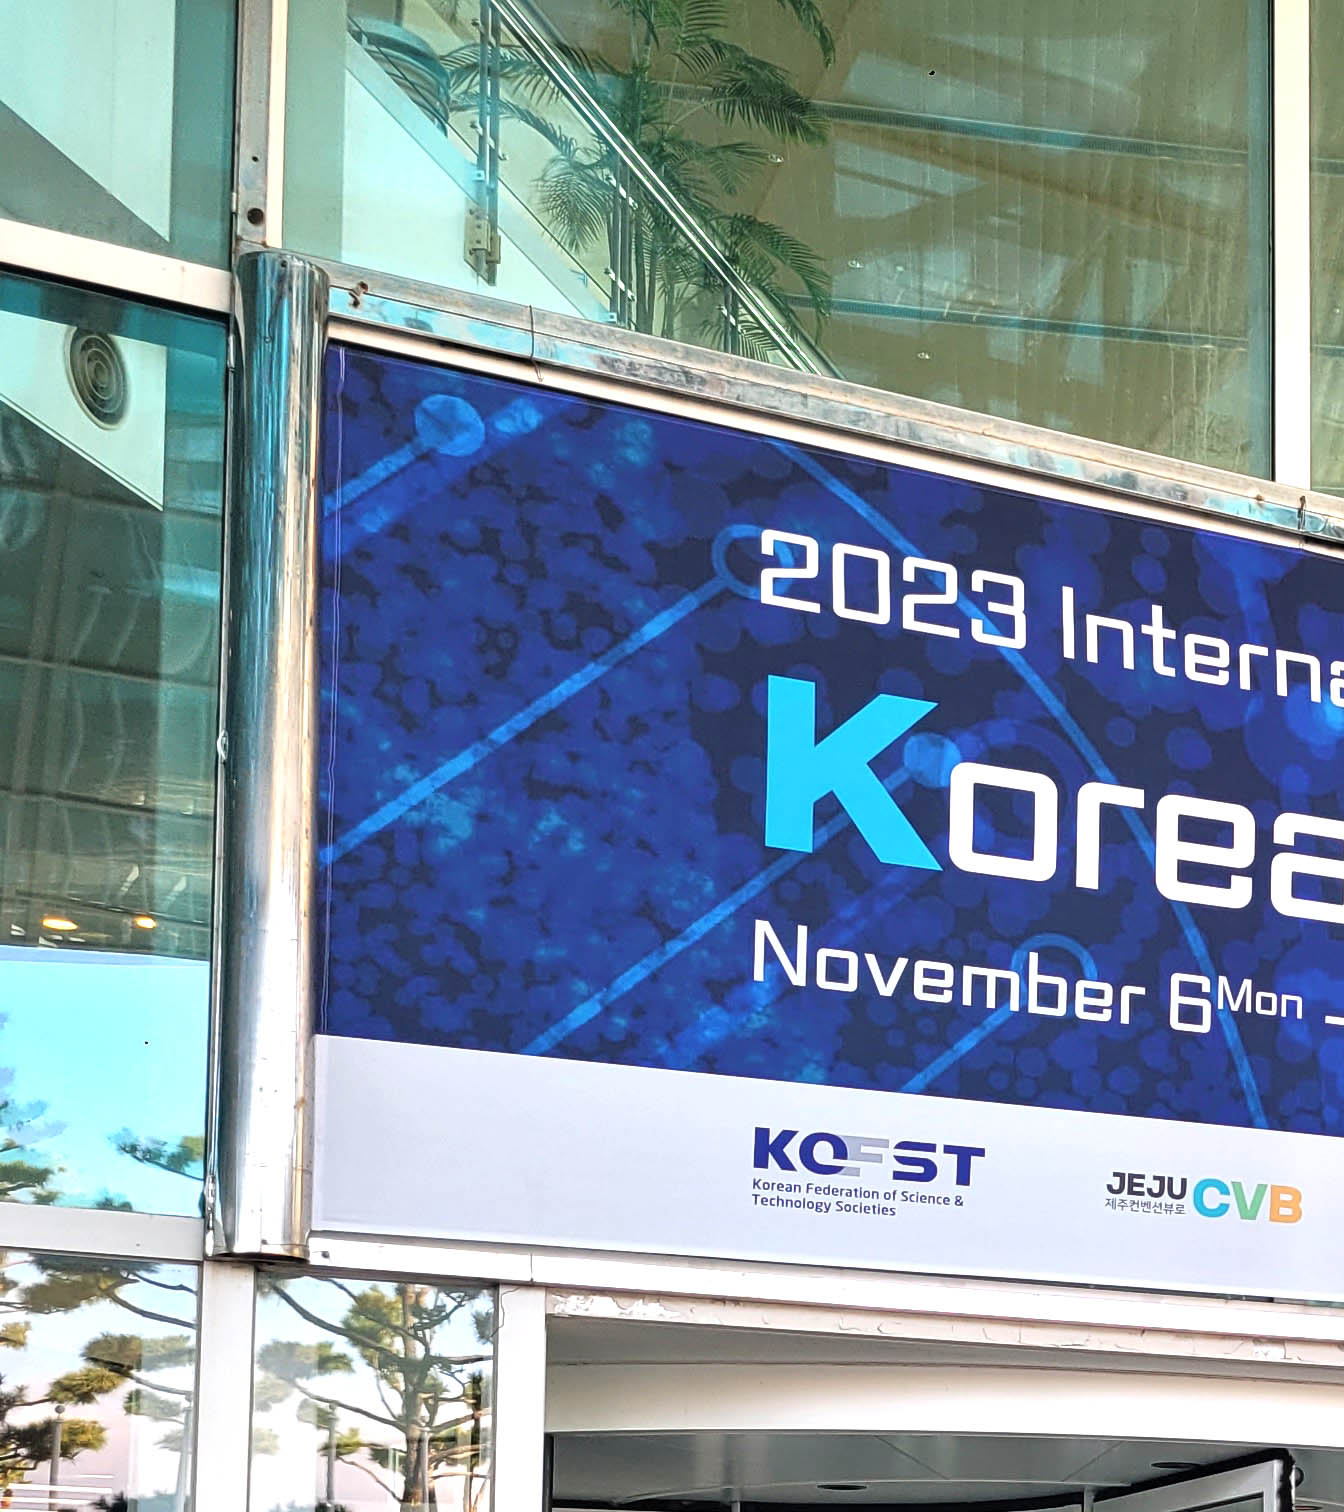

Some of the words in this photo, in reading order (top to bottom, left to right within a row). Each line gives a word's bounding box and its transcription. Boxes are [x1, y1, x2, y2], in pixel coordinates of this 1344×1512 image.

[759, 528, 1027, 651] 2023
[753, 919, 1146, 1027] November
[752, 1178, 801, 1194] Korean
[806, 1182, 880, 1201] Federation
[884, 1190, 897, 1202] of
[901, 1191, 951, 1206] Science
[954, 1195, 964, 1207] &
[752, 1193, 832, 1214] Technology
[836, 1201, 896, 1217] Societies
[1104, 1197, 1187, 1216] 제주컨벤션뷰로
[1106, 1171, 1188, 1201] JEJU
[1193, 1178, 1303, 1224] CVB
